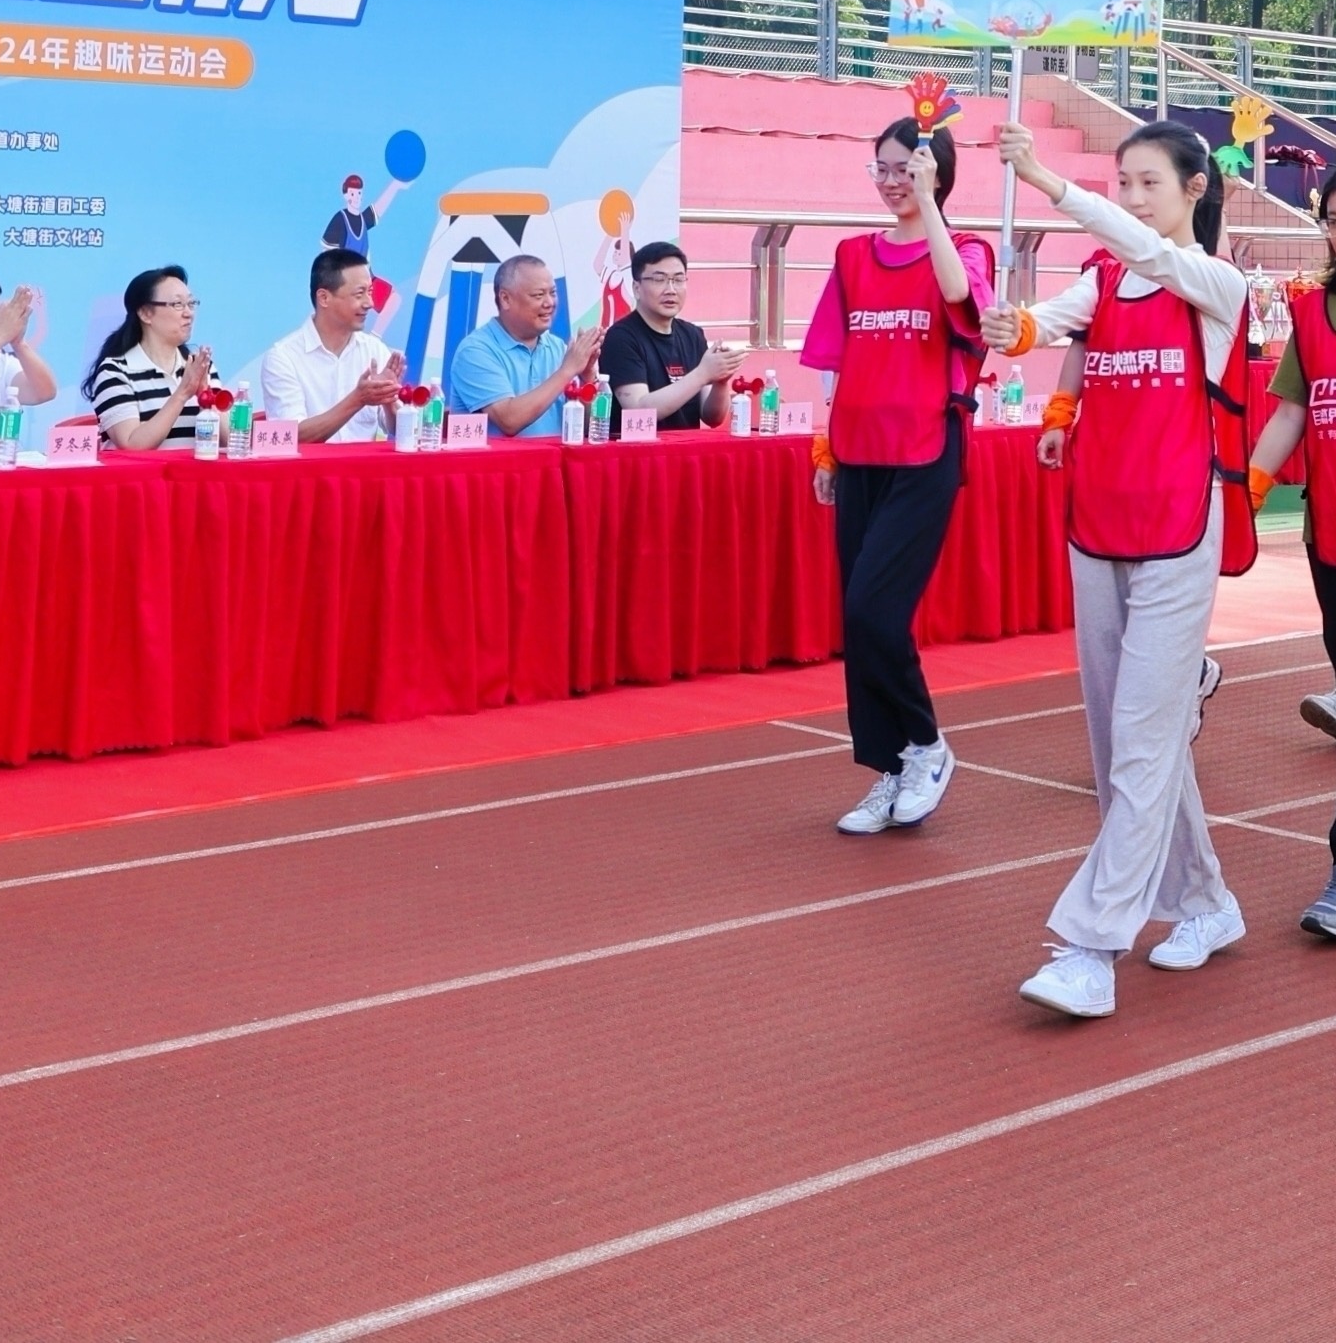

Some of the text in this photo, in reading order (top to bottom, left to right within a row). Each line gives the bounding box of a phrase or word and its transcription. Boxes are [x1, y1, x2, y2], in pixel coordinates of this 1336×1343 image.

[1043, 56, 1068, 73] 谨防丢
[3, 226, 104, 247] 大塘街文化站
[256, 430, 294, 447] 邹春燕
[451, 422, 484, 439] 梁志伟
[52, 436, 93, 454] 罗冬英
